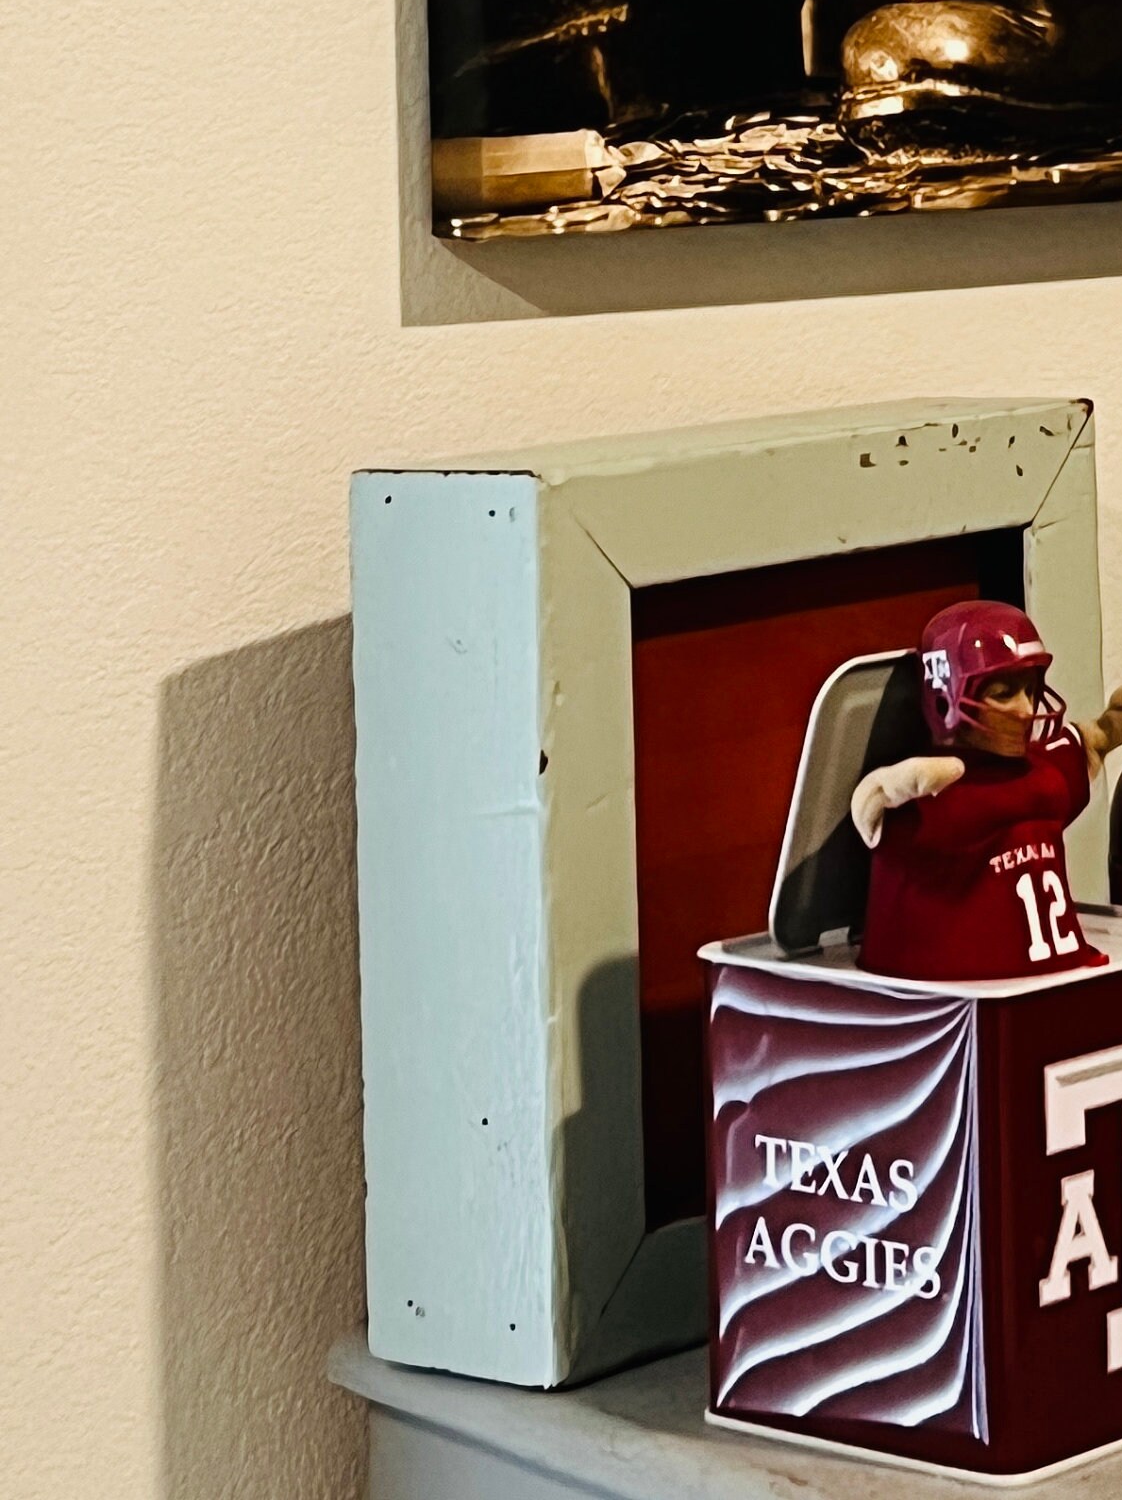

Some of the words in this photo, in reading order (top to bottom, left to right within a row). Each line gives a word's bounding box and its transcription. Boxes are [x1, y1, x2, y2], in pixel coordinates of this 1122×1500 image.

[1015, 869, 1079, 962] 12
[754, 1134, 918, 1214] TEXAS
[744, 1215, 942, 1300] AGGIES
